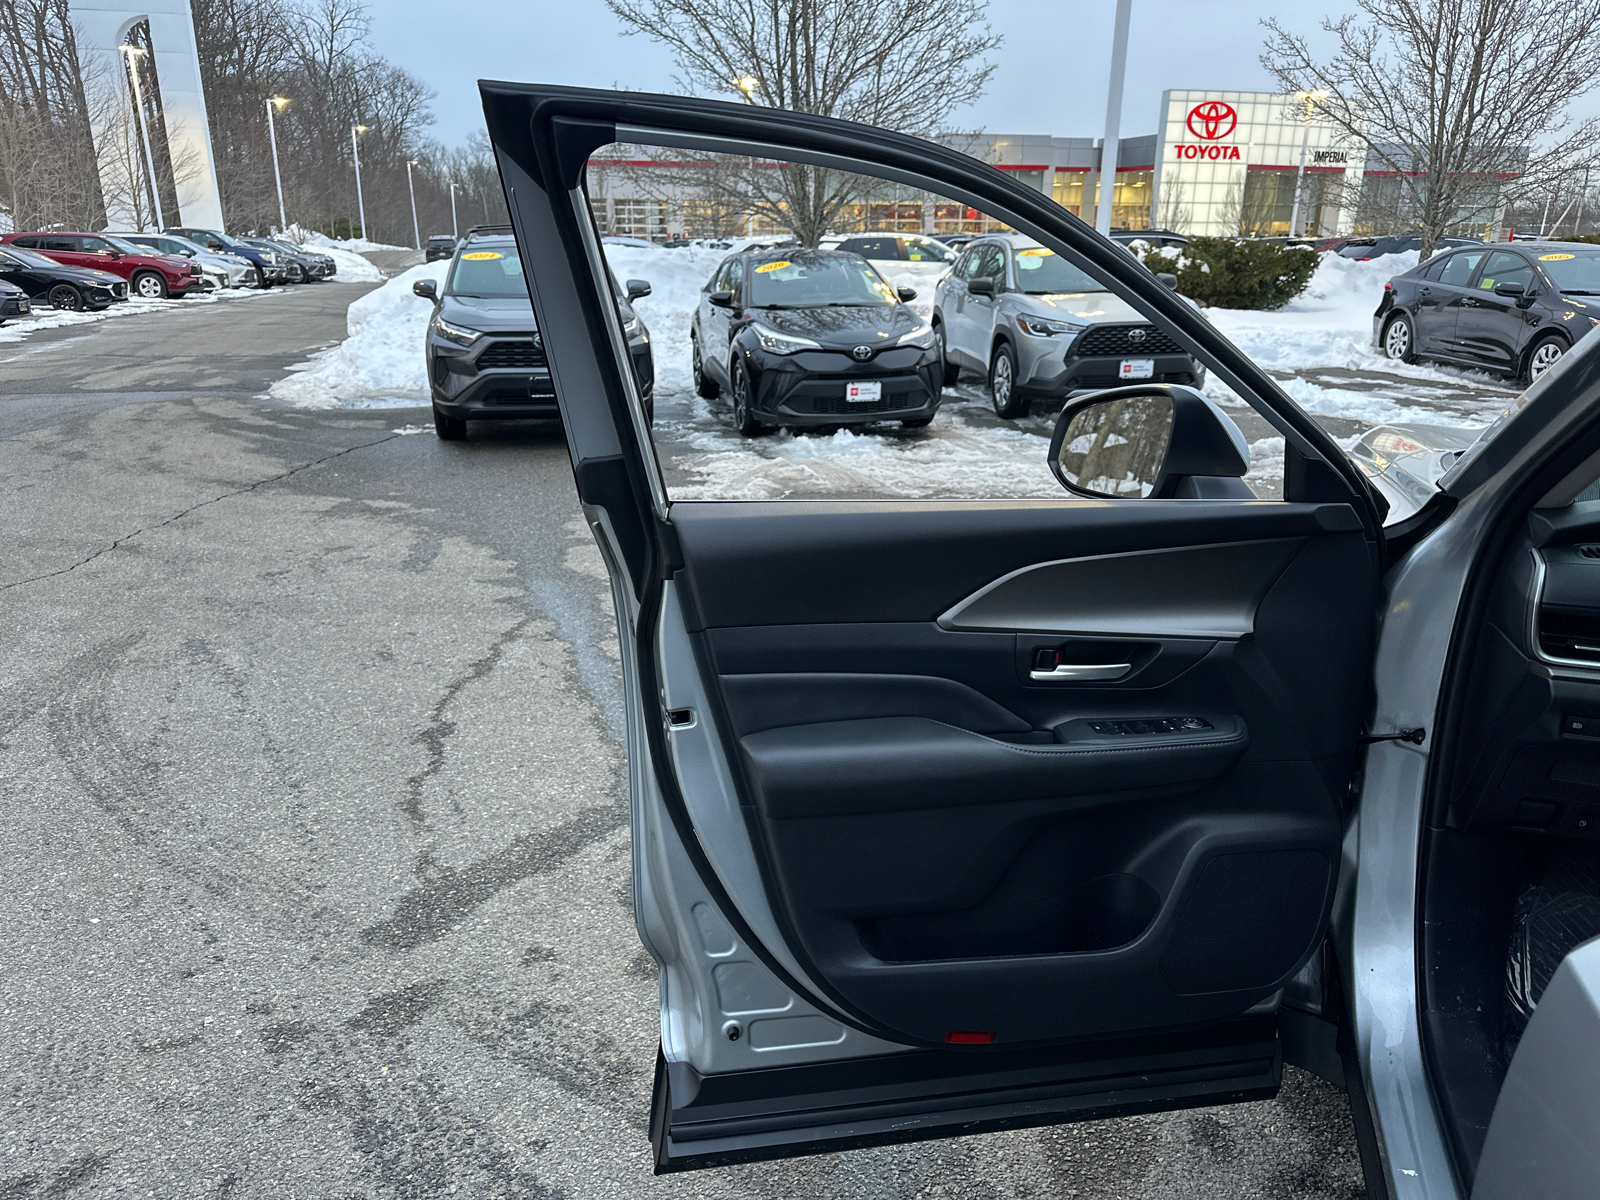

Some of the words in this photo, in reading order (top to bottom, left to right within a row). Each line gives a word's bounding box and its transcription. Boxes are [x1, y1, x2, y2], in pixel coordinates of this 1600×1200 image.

[1174, 145, 1241, 160] TOYOTA
[1314, 151, 1348, 163] IMPERIAL
[761, 262, 786, 271] 2020
